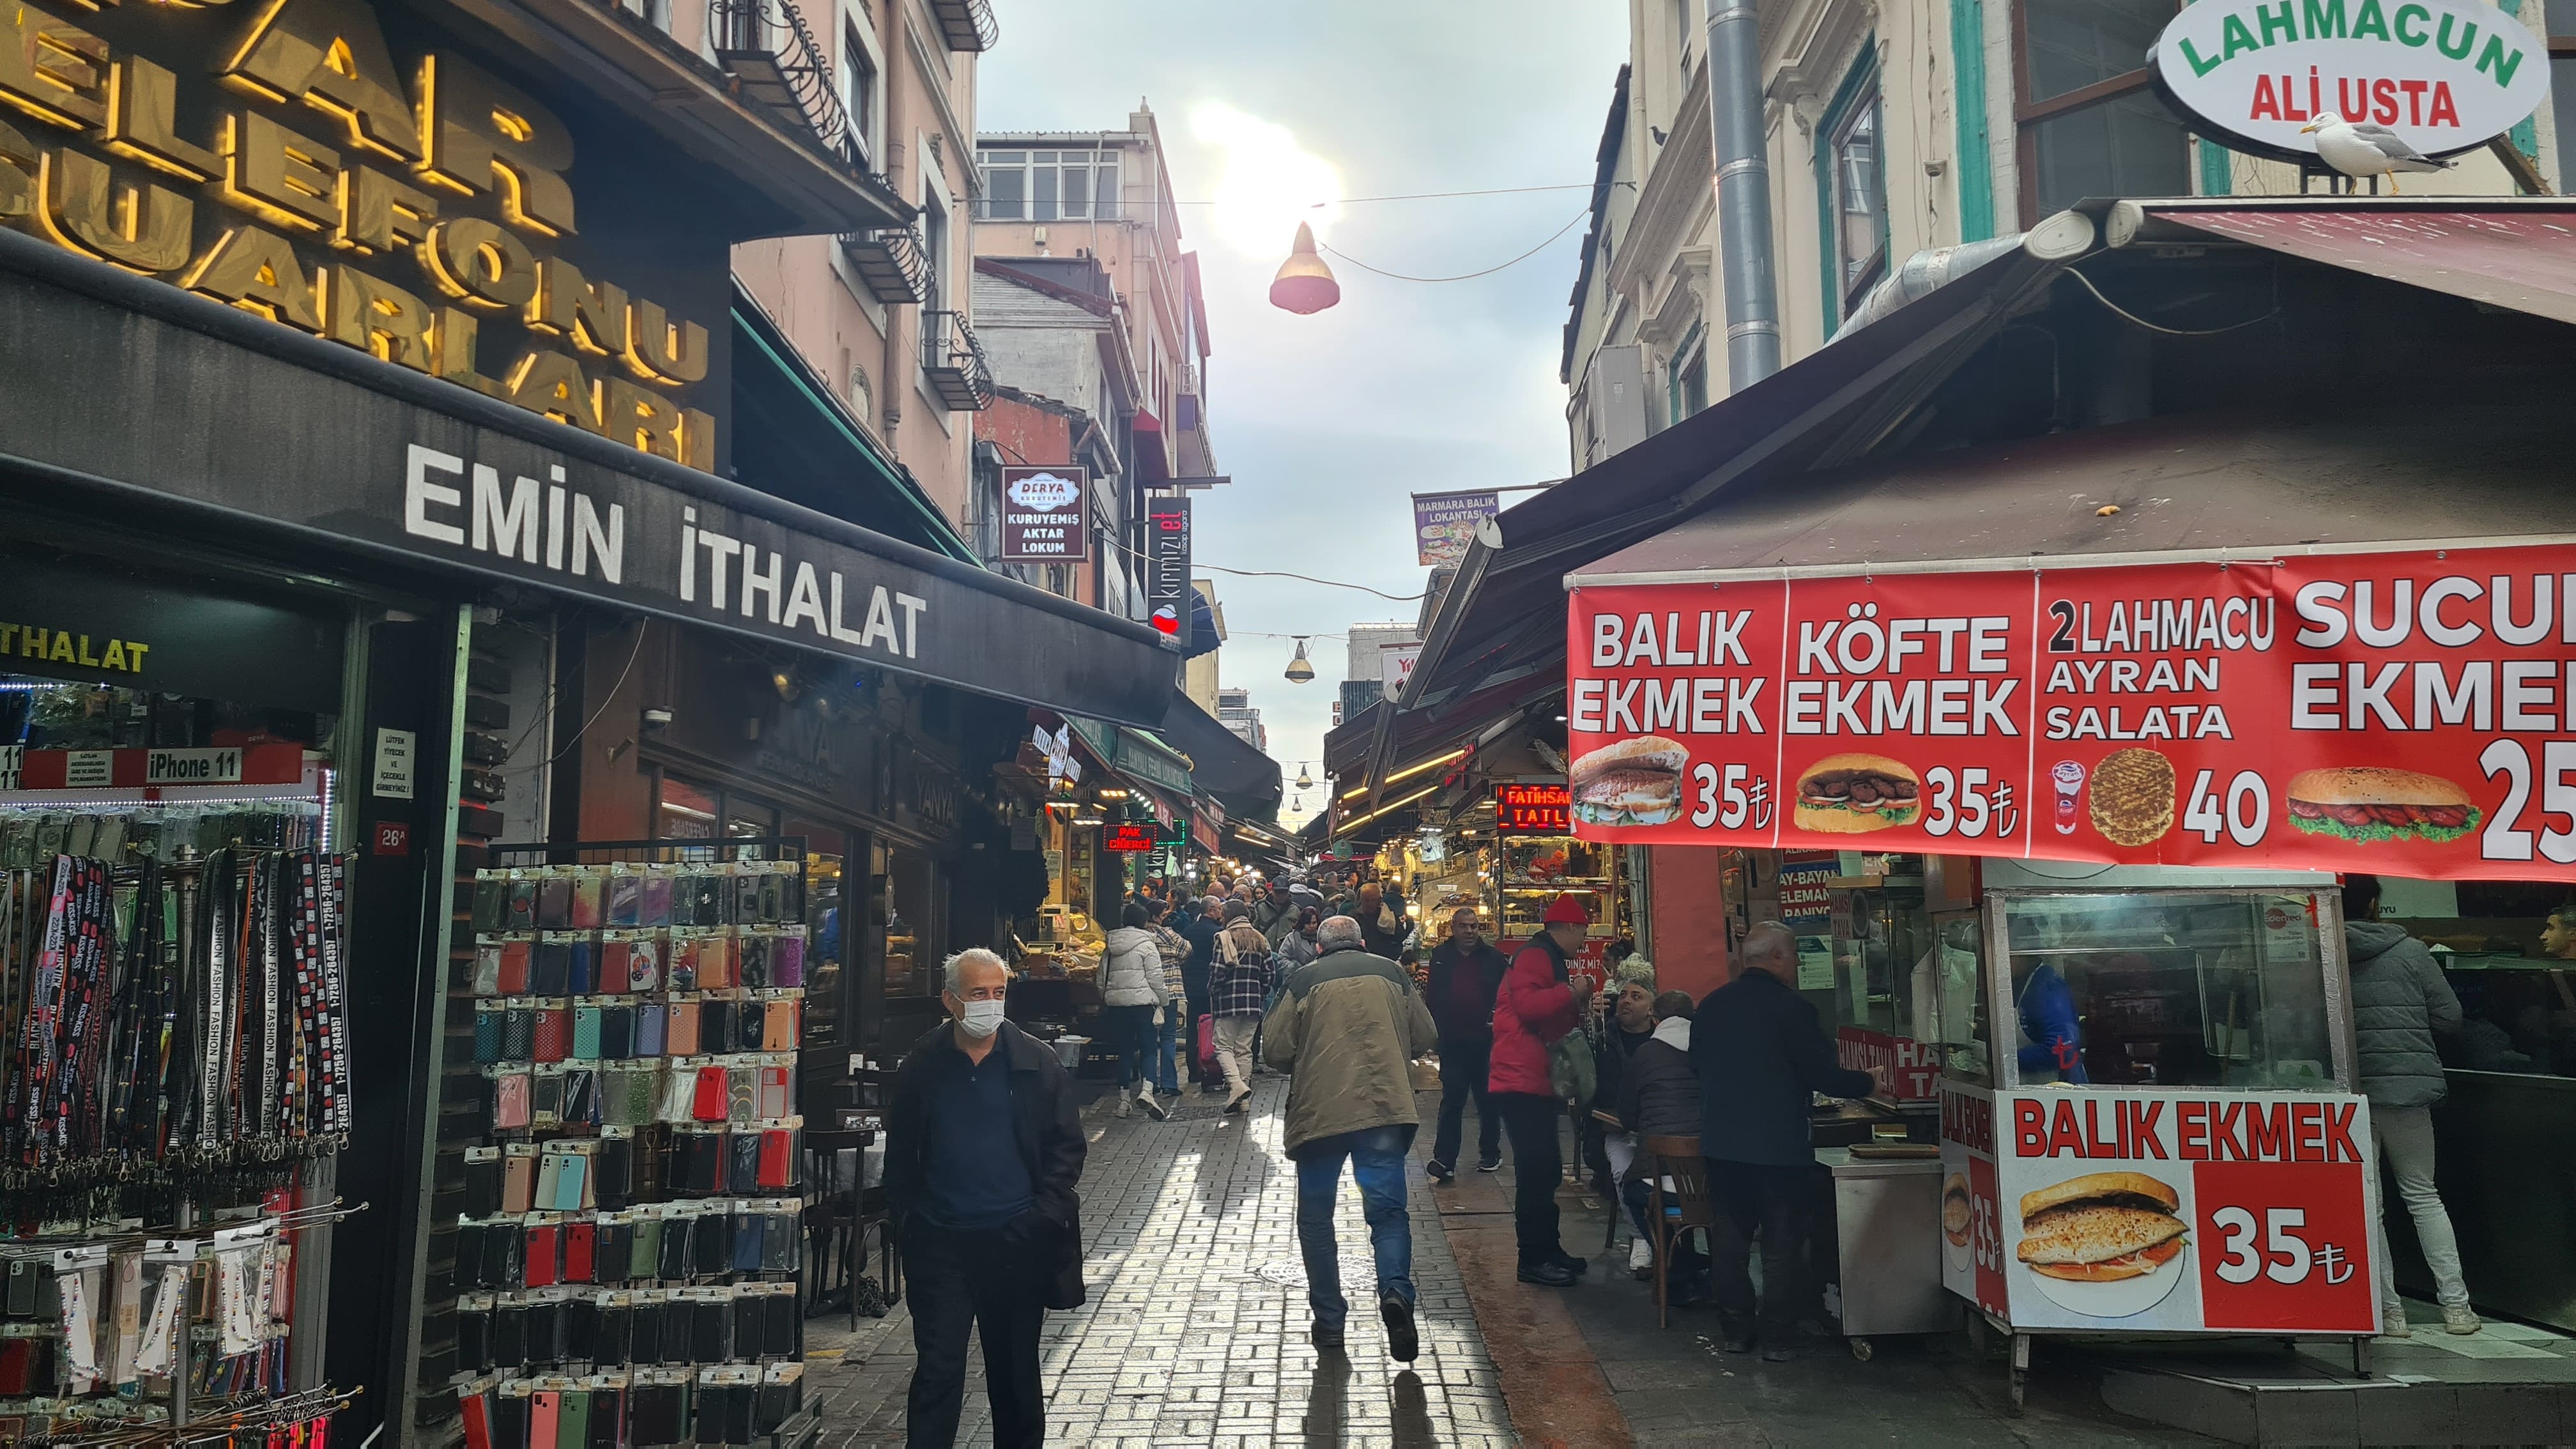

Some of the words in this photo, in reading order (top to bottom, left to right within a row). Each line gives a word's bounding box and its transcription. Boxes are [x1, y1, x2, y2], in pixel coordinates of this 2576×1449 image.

[2178, 0, 2524, 89] LAHMACUN
[2250, 65, 2320, 122] ALİ
[2337, 76, 2460, 128] USTA
[1022, 482, 1065, 495] DERYA
[1416, 499, 1465, 513] MARMARA
[1466, 496, 1496, 510] BALIK
[1022, 528, 1064, 539] AKTAR
[1151, 510, 1182, 530] et
[1429, 509, 1482, 523] LOKANTASI
[404, 443, 624, 585] EMİN
[678, 505, 927, 659] İTHALAT
[1022, 542, 1065, 553] LOKUM
[1591, 609, 1754, 668] BALIK
[1797, 601, 2011, 675] KÖFTE
[2047, 599, 2078, 656] 2
[2080, 595, 2276, 654] LAHMACU
[0, 622, 149, 673] THALAT
[2045, 656, 2220, 694] AYRAN
[1570, 677, 1767, 734] EKMEK
[1786, 678, 2021, 737] EKMEK
[2046, 704, 2233, 742] SALATA
[383, 747, 405, 757] YİYECEK
[385, 735, 404, 745] LÜTFEN
[148, 751, 210, 779] iPhone
[215, 751, 236, 778] 11
[380, 770, 406, 781] İÇECEKLE
[2182, 769, 2270, 848] 40
[1119, 827, 1142, 838] PAK
[268, 916, 277, 956] FASHION
[212, 964, 222, 1006] FASHION
[267, 962, 277, 1003] FASHION
[209, 1011, 220, 1055] FASHION
[266, 1009, 275, 1052] FASHION
[206, 1062, 217, 1106] FASHION
[264, 1057, 273, 1099] FASHION
[2013, 1098, 2169, 1160] BALIK
[2176, 1100, 2364, 1163] EKMEK
